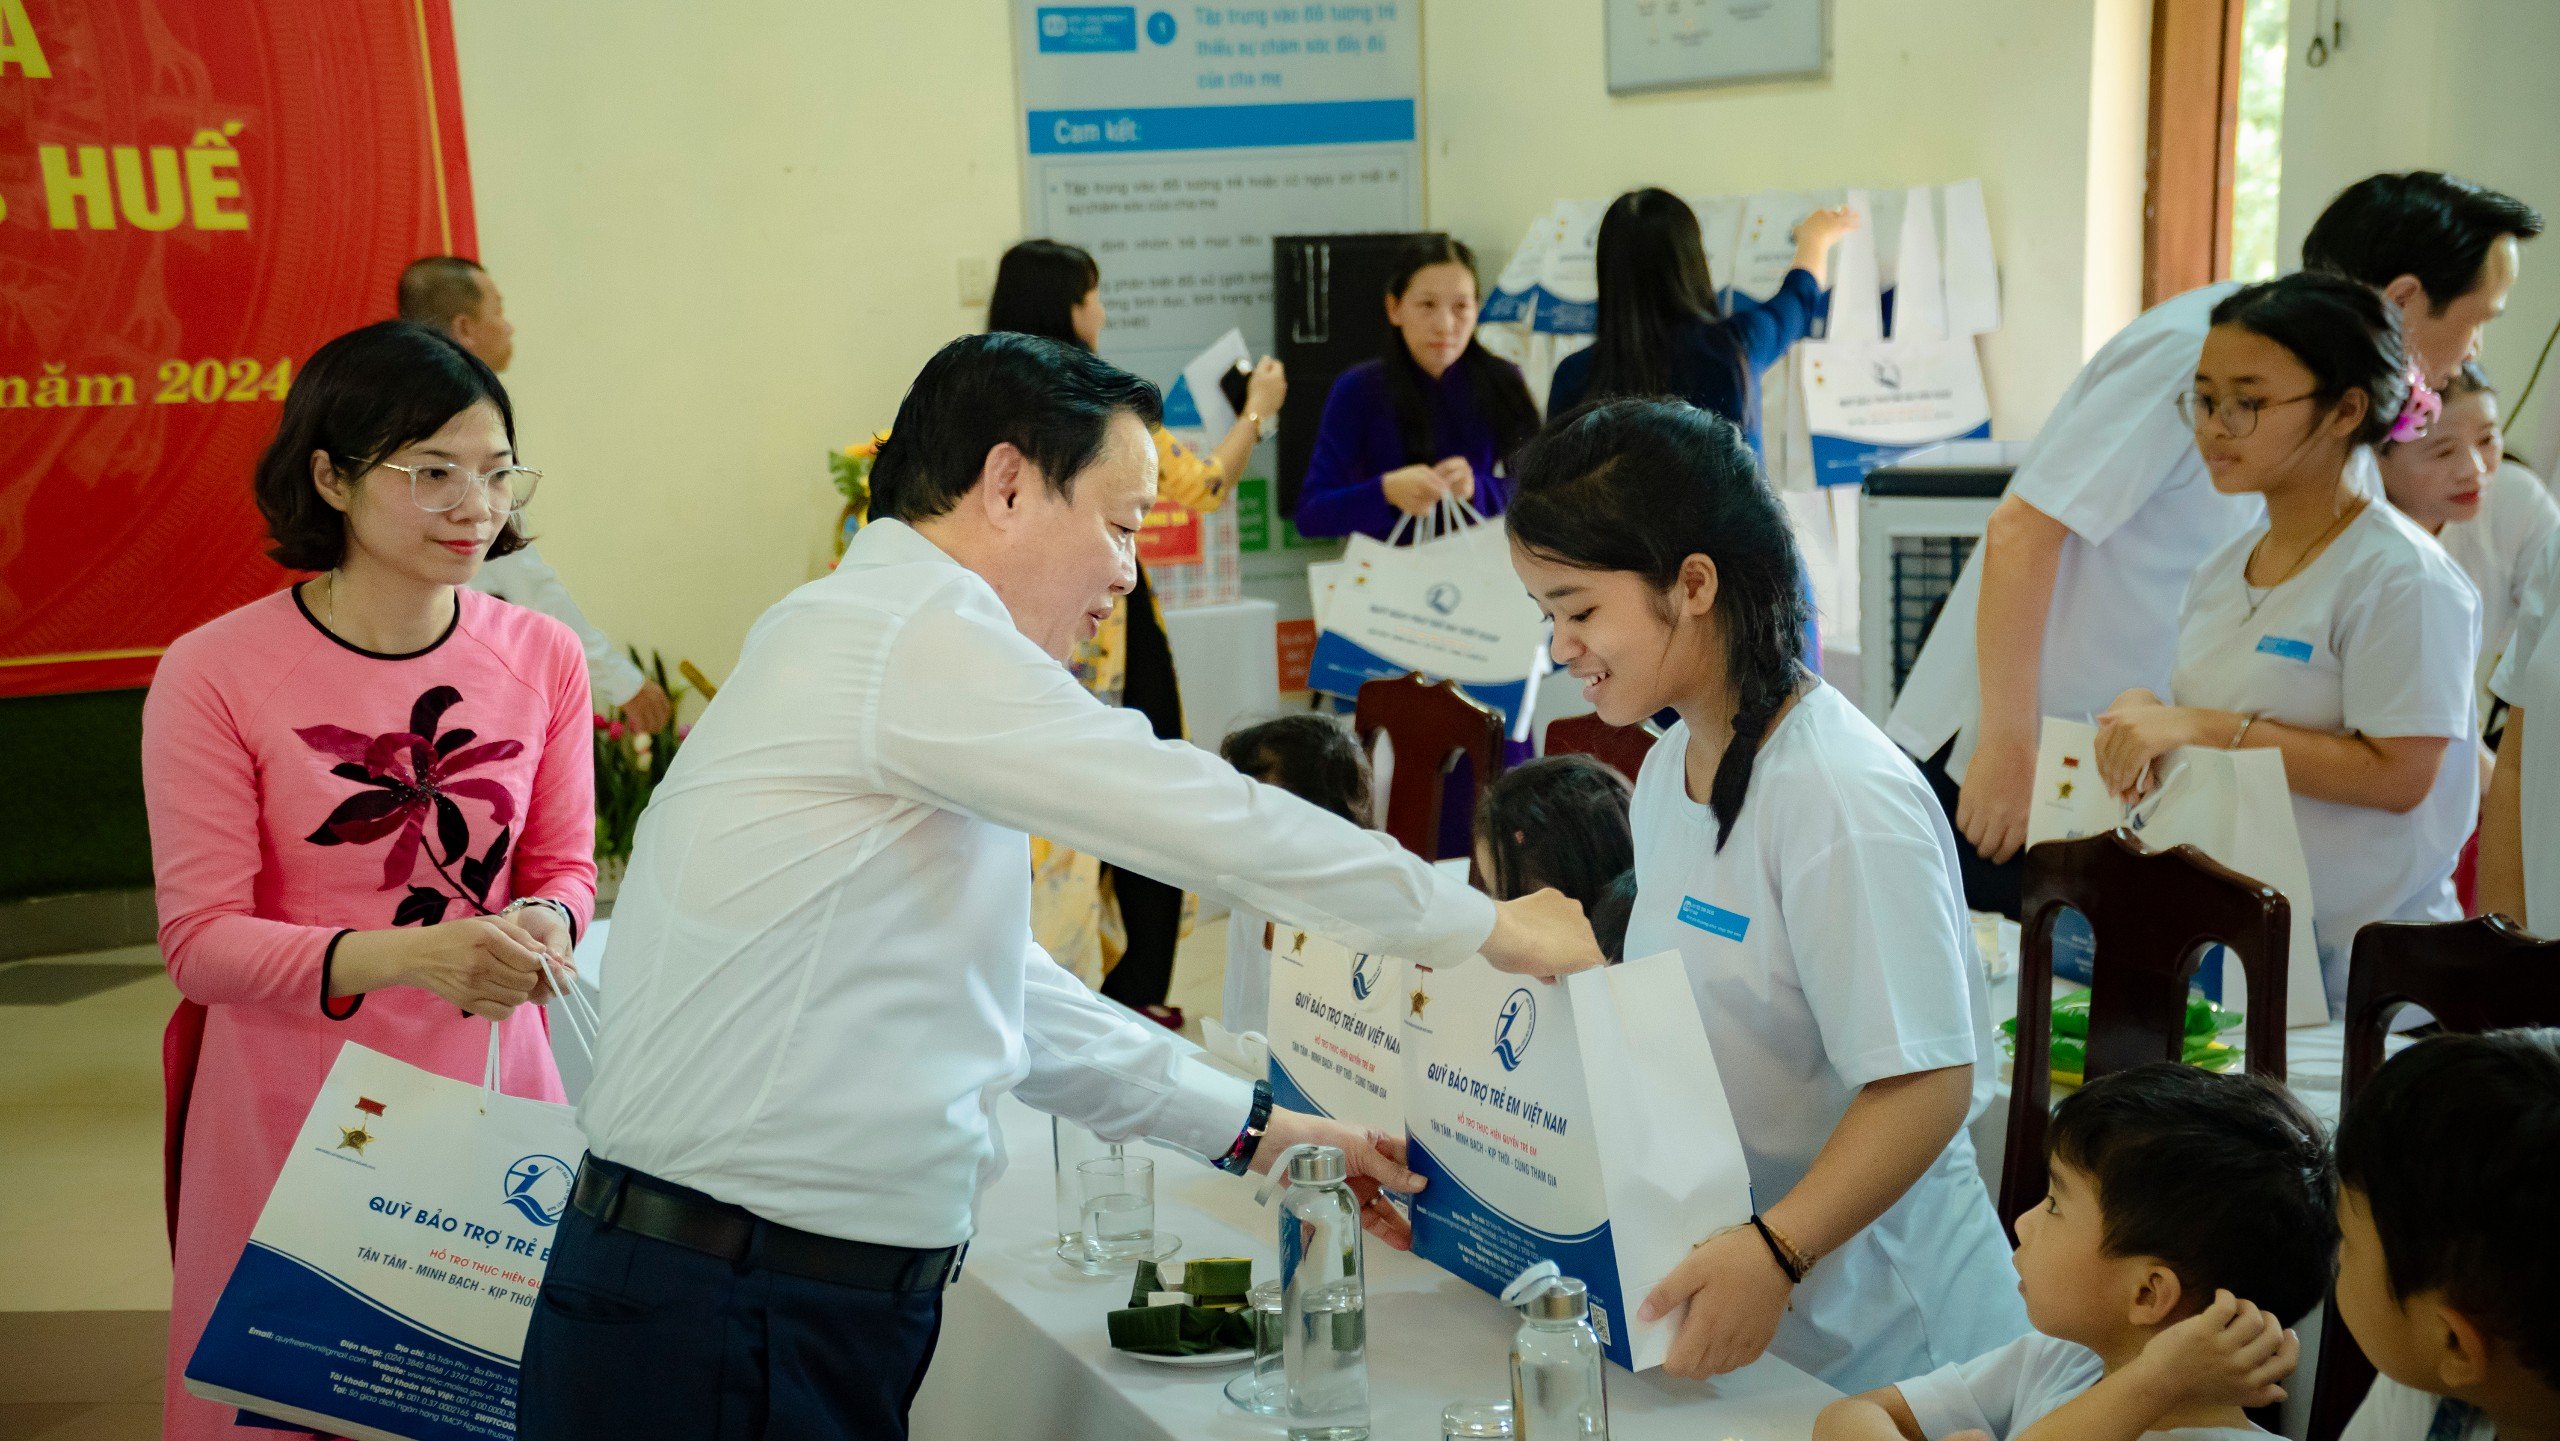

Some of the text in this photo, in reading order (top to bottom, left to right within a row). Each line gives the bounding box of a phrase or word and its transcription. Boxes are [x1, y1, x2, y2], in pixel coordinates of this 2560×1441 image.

[1054, 119, 1099, 144] Cam
[39, 121, 249, 231] HUẾ
[0, 357, 292, 408] năm 2024
[1295, 992, 1311, 1009] QUỸ
[1310, 996, 1326, 1018] BẢO
[1326, 1007, 1342, 1029] TRỢ
[1341, 1013, 1356, 1032] TRẺ
[1354, 1021, 1367, 1038] EM
[1368, 1026, 1385, 1048] VIỆT
[1428, 1062, 1568, 1136] QUỸ BẢO TRỢ TRẺ EM VIỆT NAM
[1441, 1122, 1451, 1138] TÂM
[1455, 1131, 1469, 1145] MINH
[1470, 1138, 1484, 1155] BẠCH
[1531, 1166, 1546, 1183] THAM
[1547, 1174, 1558, 1188] GIA
[1529, 1146, 1537, 1156] EM
[369, 1196, 413, 1219] QUỸ
[414, 1208, 458, 1233] BẢO
[463, 1222, 502, 1249] TRỢ
[505, 1235, 538, 1257] TRẺ
[357, 1246, 380, 1263] TẬN
[382, 1253, 407, 1271] TÂM
[415, 1264, 447, 1282] MINH
[449, 1275, 479, 1292] BẠCH
[488, 1285, 507, 1301] KỊP
[429, 1249, 447, 1261] HỖ
[449, 1254, 470, 1269] TRỢ
[472, 1261, 499, 1276] THỰC
[501, 1269, 526, 1285] HIỆN
[248, 1326, 274, 1340] Email:
[373, 1360, 406, 1375] Website:
[330, 1372, 342, 1381] Tài
[381, 1374, 393, 1383] Tài
